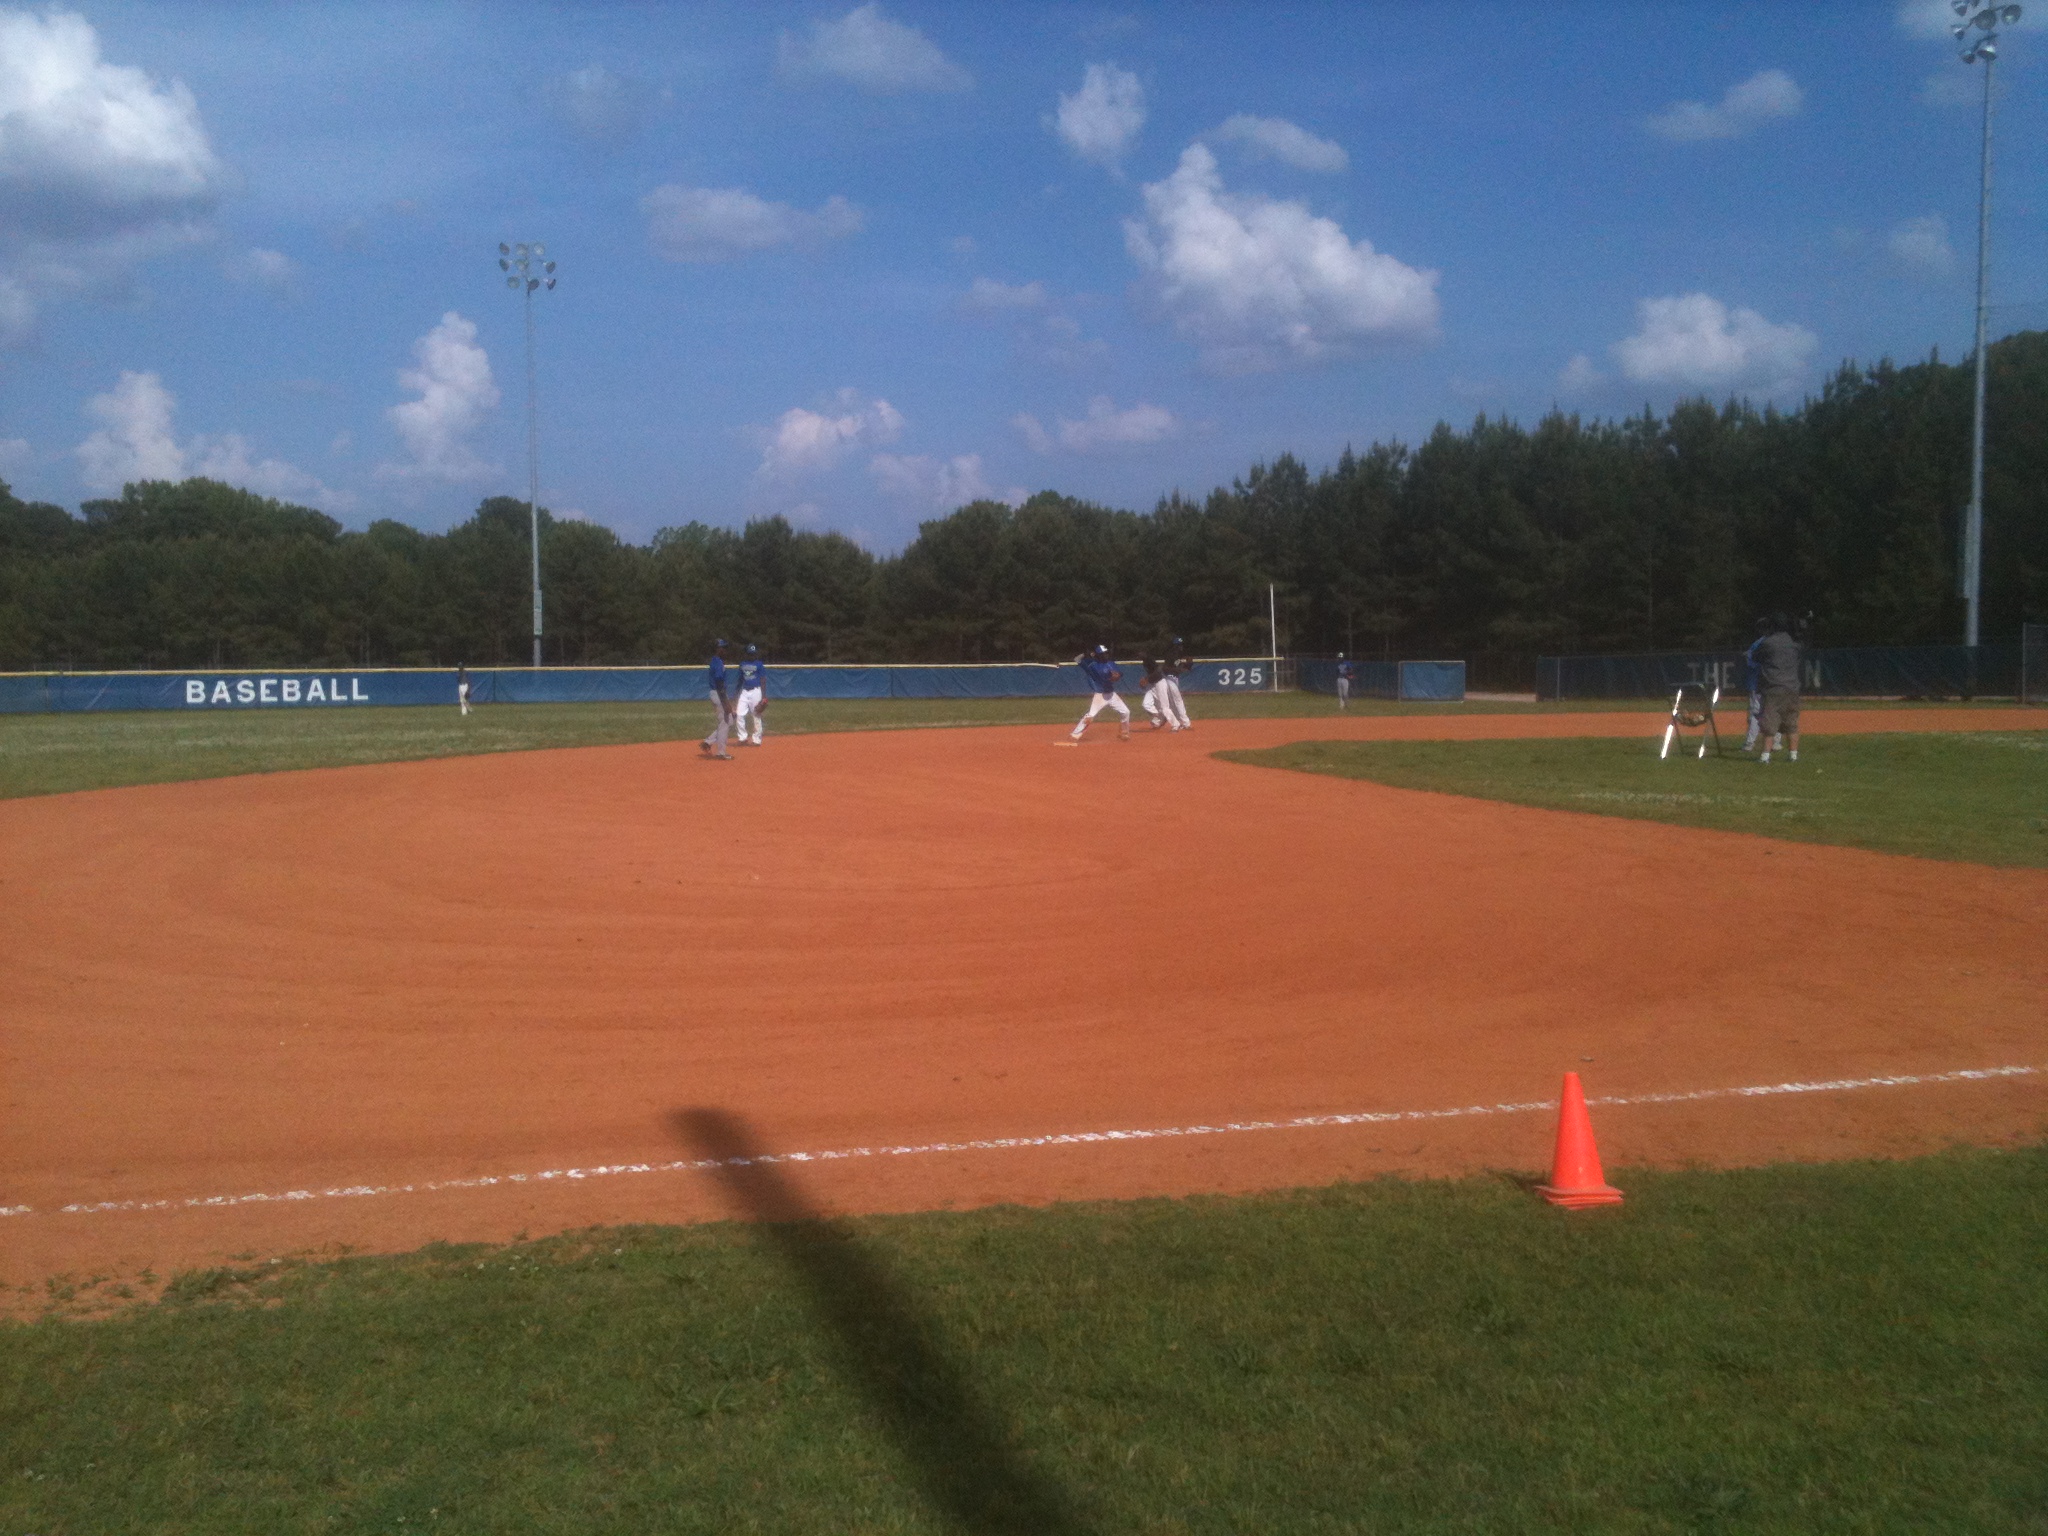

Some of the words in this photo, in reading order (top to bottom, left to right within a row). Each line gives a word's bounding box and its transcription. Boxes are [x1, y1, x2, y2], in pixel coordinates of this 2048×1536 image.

[1217, 667, 1263, 686] 325
[1687, 661, 1736, 689] THE
[186, 677, 369, 704] BASEBALL
